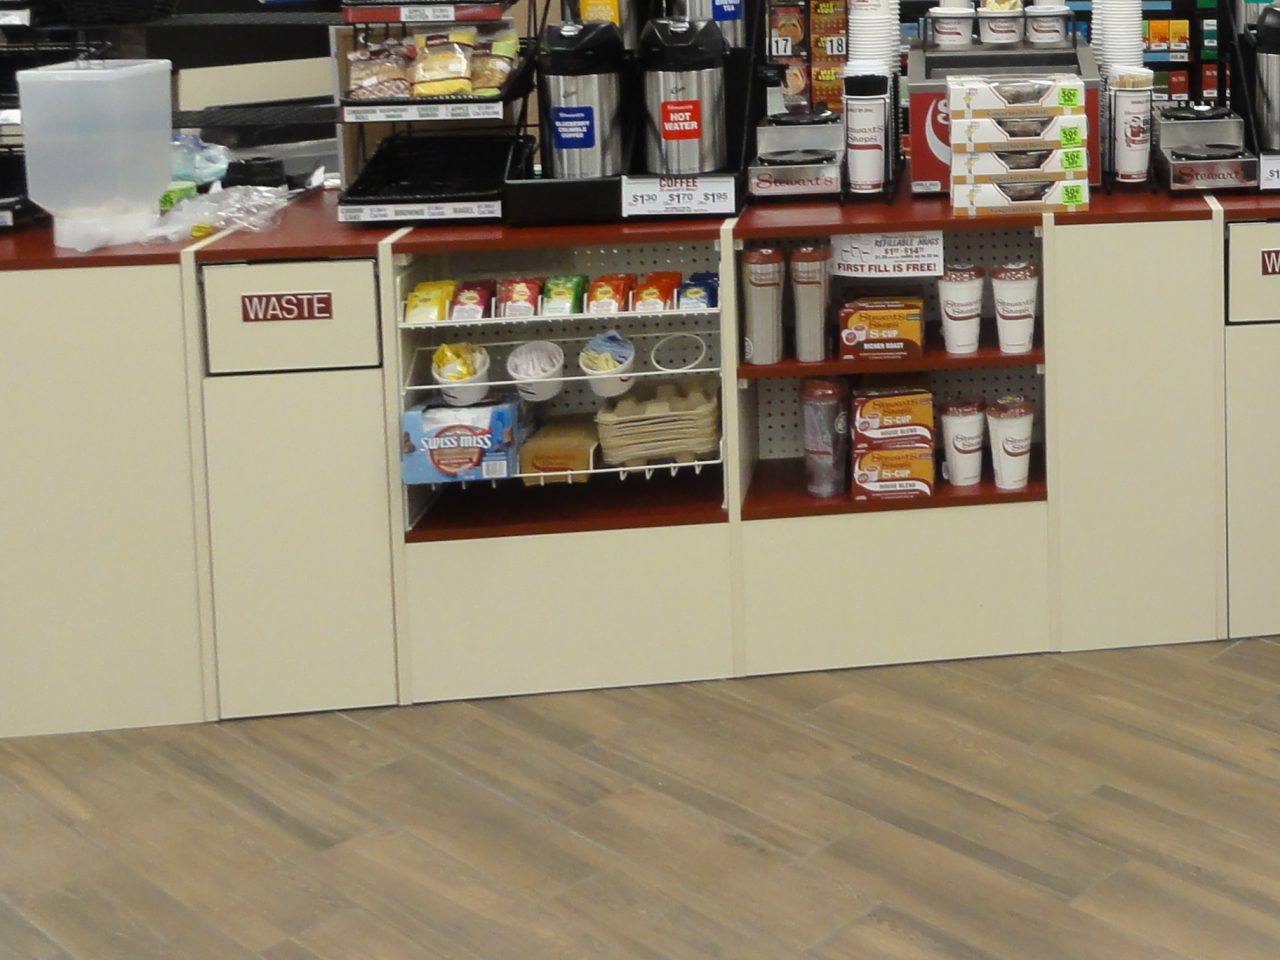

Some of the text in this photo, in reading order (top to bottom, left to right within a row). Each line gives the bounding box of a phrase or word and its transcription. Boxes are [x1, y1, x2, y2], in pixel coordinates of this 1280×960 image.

[774, 39, 789, 53] 17
[829, 38, 844, 53] 18
[670, 112, 691, 121] HOT
[664, 122, 698, 131] WATER
[659, 177, 698, 189] COFFEE
[875, 239, 915, 247] REFILLABLE
[837, 262, 937, 273] FIRST FILL IS FREE!
[244, 294, 330, 320] WASTE
